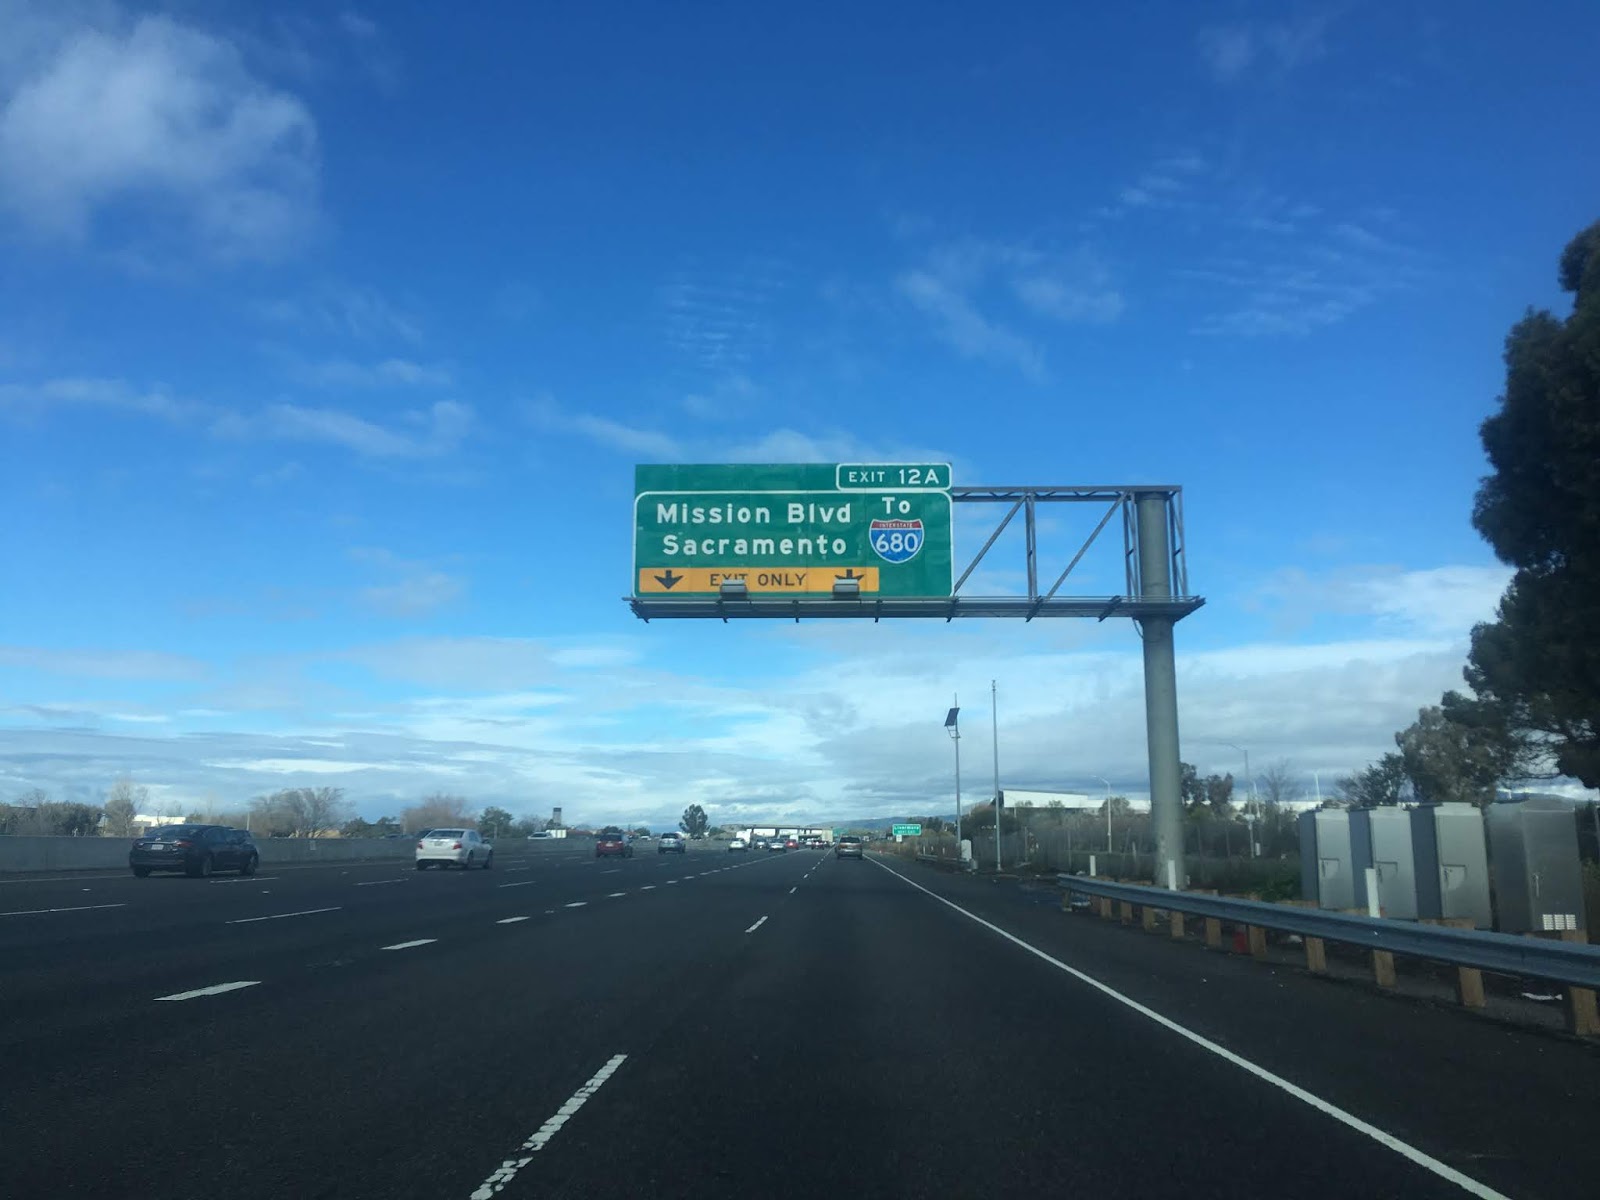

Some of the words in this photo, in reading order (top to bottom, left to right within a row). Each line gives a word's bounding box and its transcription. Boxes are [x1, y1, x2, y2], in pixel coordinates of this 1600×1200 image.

[848, 471, 885, 483] EXIT
[899, 468, 940, 485] 12A
[656, 503, 770, 524] Mission
[787, 503, 851, 524] Blvd
[881, 496, 911, 515] To
[662, 534, 847, 556] Sacramento
[875, 532, 919, 553] 680
[757, 573, 807, 587] ONLY
